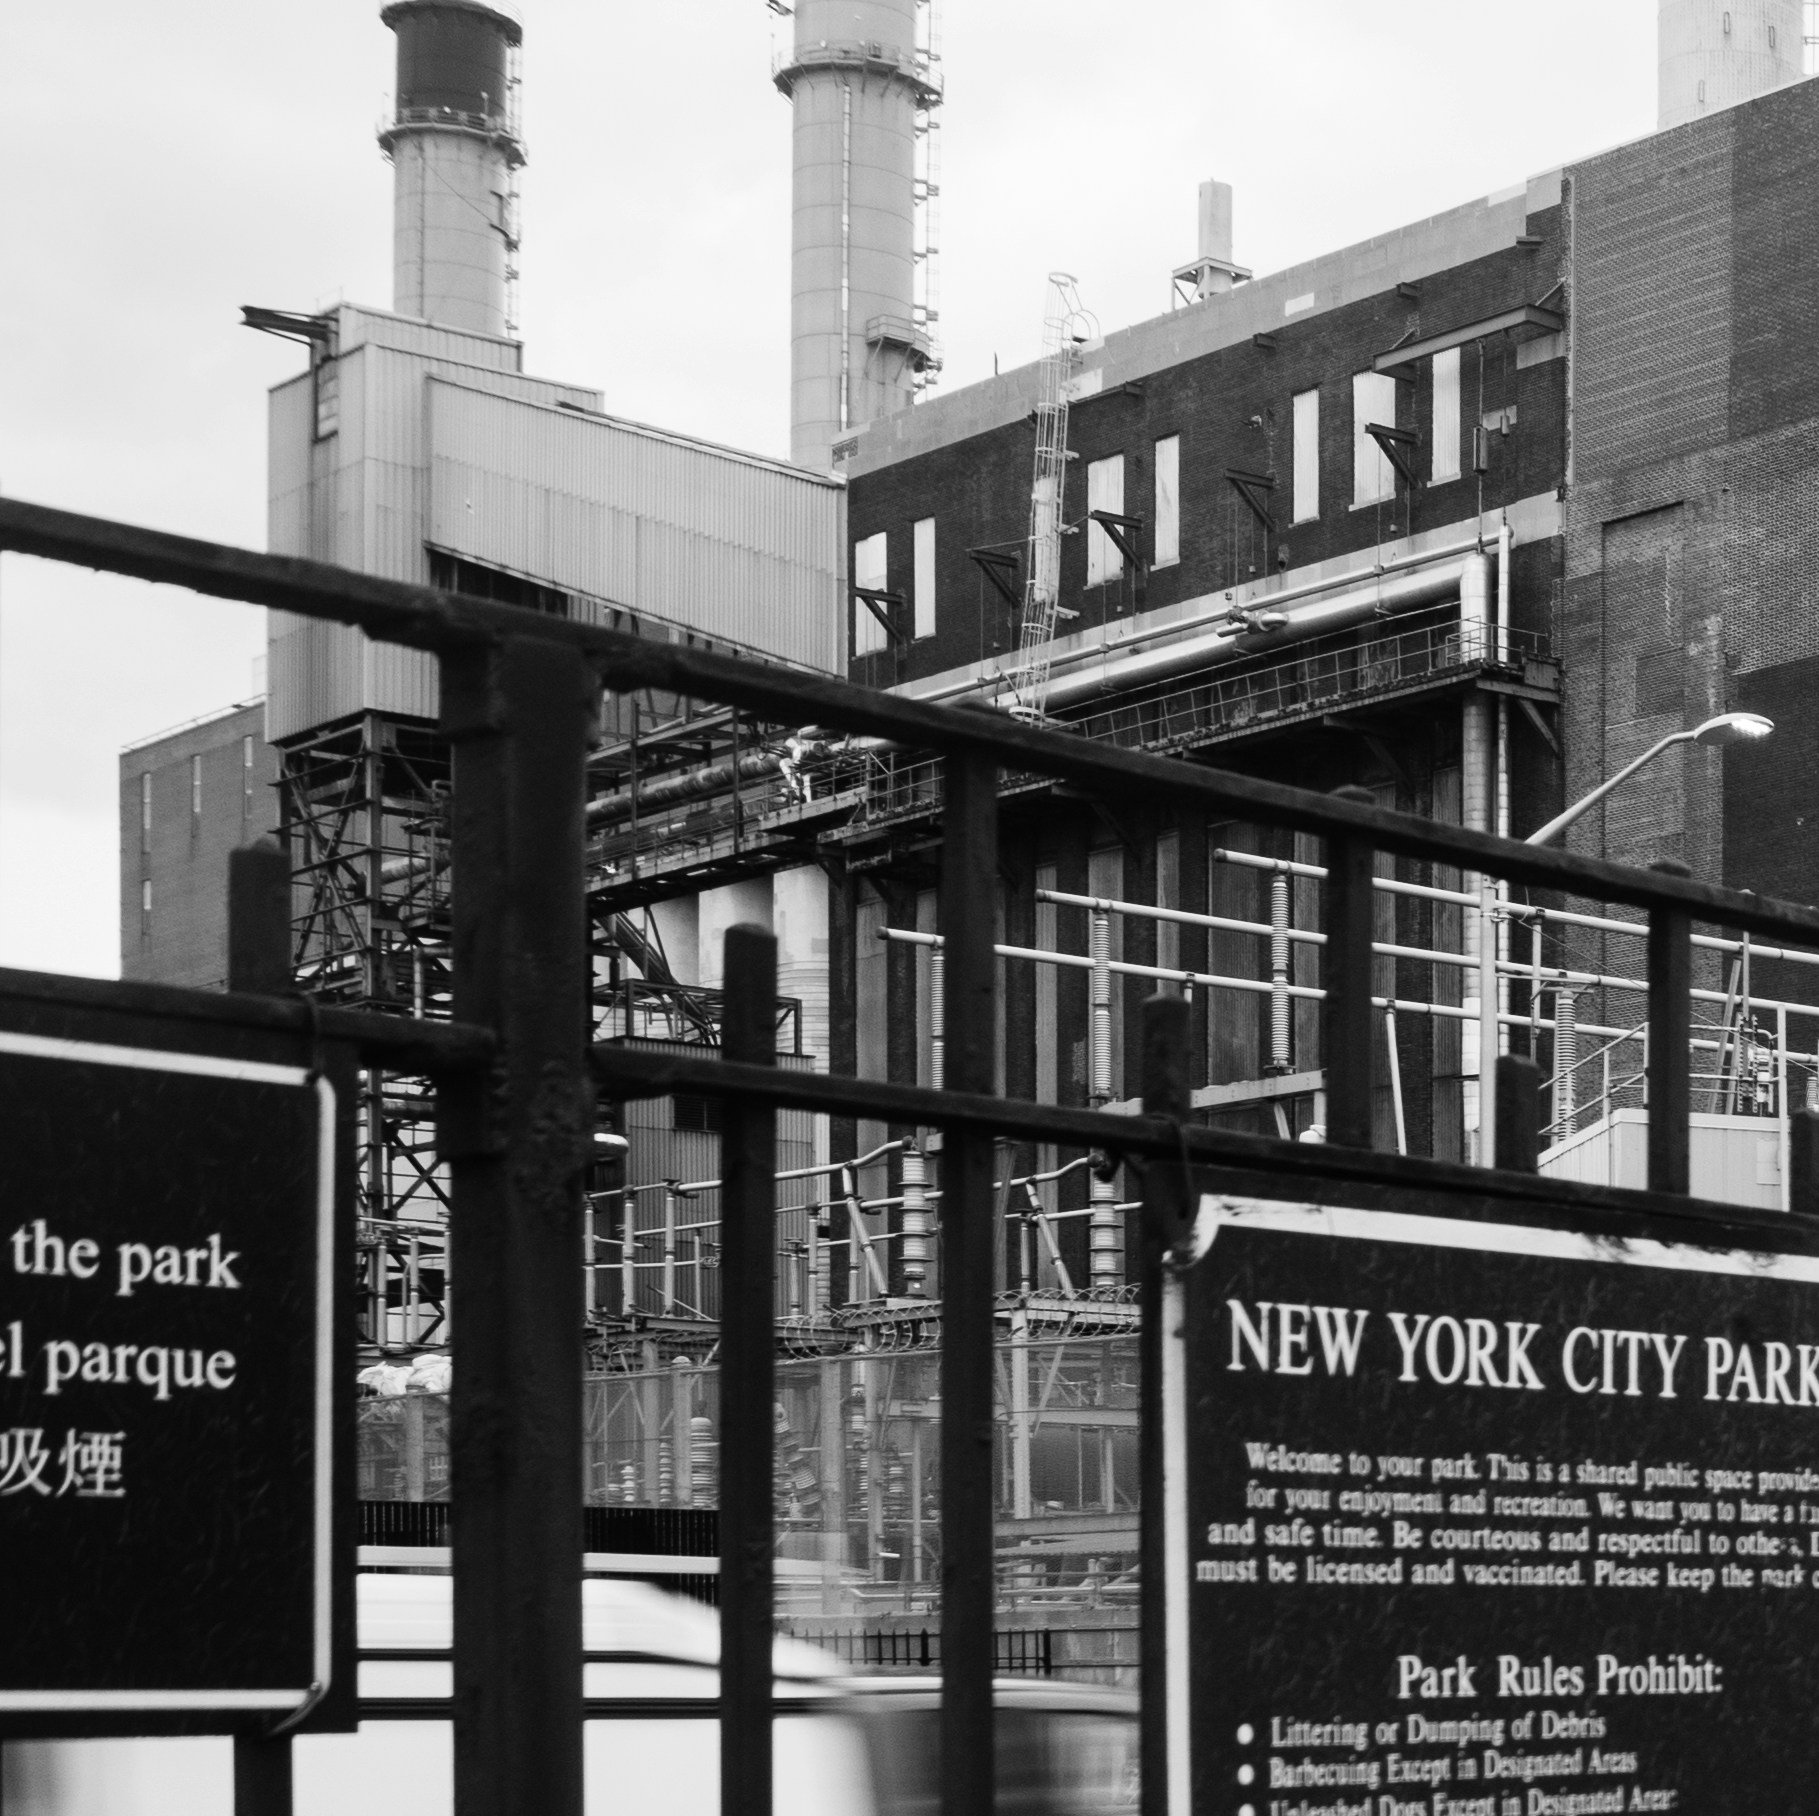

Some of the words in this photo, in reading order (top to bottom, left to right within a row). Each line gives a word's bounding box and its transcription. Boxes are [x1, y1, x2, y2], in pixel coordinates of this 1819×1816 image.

[10, 1218, 100, 1278] the
[115, 1232, 242, 1296] park
[0, 1320, 26, 1378] l
[43, 1340, 237, 1400] parque
[1226, 1298, 1369, 1376] NEW
[1386, 1311, 1545, 1390] YORK
[1561, 1325, 1688, 1398] CITY
[1244, 1441, 1342, 1474] Welcome
[1347, 1451, 1371, 1476] to
[1376, 1455, 1424, 1481] your
[1430, 1452, 1481, 1483] park.
[1485, 1452, 1530, 1481] This
[1535, 1455, 1553, 1482] is
[1557, 1462, 1571, 1483] a
[1575, 1458, 1638, 1486] shared
[1643, 1461, 1699, 1492] public
[1703, 1468, 1753, 1494] space
[1245, 1479, 1278, 1508] for
[1284, 1487, 1330, 1514] your
[1338, 1484, 1443, 1517] enjoyment
[1448, 1488, 1487, 1515] and
[1492, 1490, 1591, 1518] recreation.
[1596, 1491, 1626, 1519] We
[1630, 1490, 1674, 1520] want
[1679, 1501, 1712, 1525] you
[1715, 1492, 1735, 1522] to
[1739, 1493, 1779, 1523] have
[1782, 1504, 1794, 1523] a
[1207, 1516, 1256, 1545] and
[1263, 1517, 1315, 1547] safe
[1320, 1518, 1383, 1548] time.
[1392, 1519, 1423, 1549] Be
[1429, 1526, 1542, 1551] courteous
[1547, 1525, 1590, 1552] and
[1597, 1527, 1701, 1558] respectful
[1707, 1532, 1730, 1555] to
[1195, 1557, 1258, 1582] must
[1266, 1555, 1297, 1583] be
[1305, 1555, 1403, 1584] licensed
[1410, 1557, 1455, 1585] and
[1462, 1558, 1585, 1586] vaccinated.
[1593, 1558, 1659, 1587] Please
[1666, 1561, 1715, 1593] keep
[1720, 1562, 1754, 1587] the
[1397, 1654, 1477, 1699] Park
[1497, 1654, 1584, 1697] Rules
[1596, 1653, 1722, 1695] Prohibit:
[1270, 1715, 1368, 1749] Littering
[1374, 1721, 1399, 1744] or
[1406, 1712, 1505, 1747] Dumping
[1510, 1710, 1535, 1740] of
[1540, 1709, 1606, 1739] Debris
[1268, 1755, 1380, 1789] Barbecuing
[1386, 1752, 1451, 1787] Except
[1457, 1751, 1477, 1779] in
[1482, 1747, 1582, 1783] Designated
[1587, 1747, 1637, 1774] Areas
